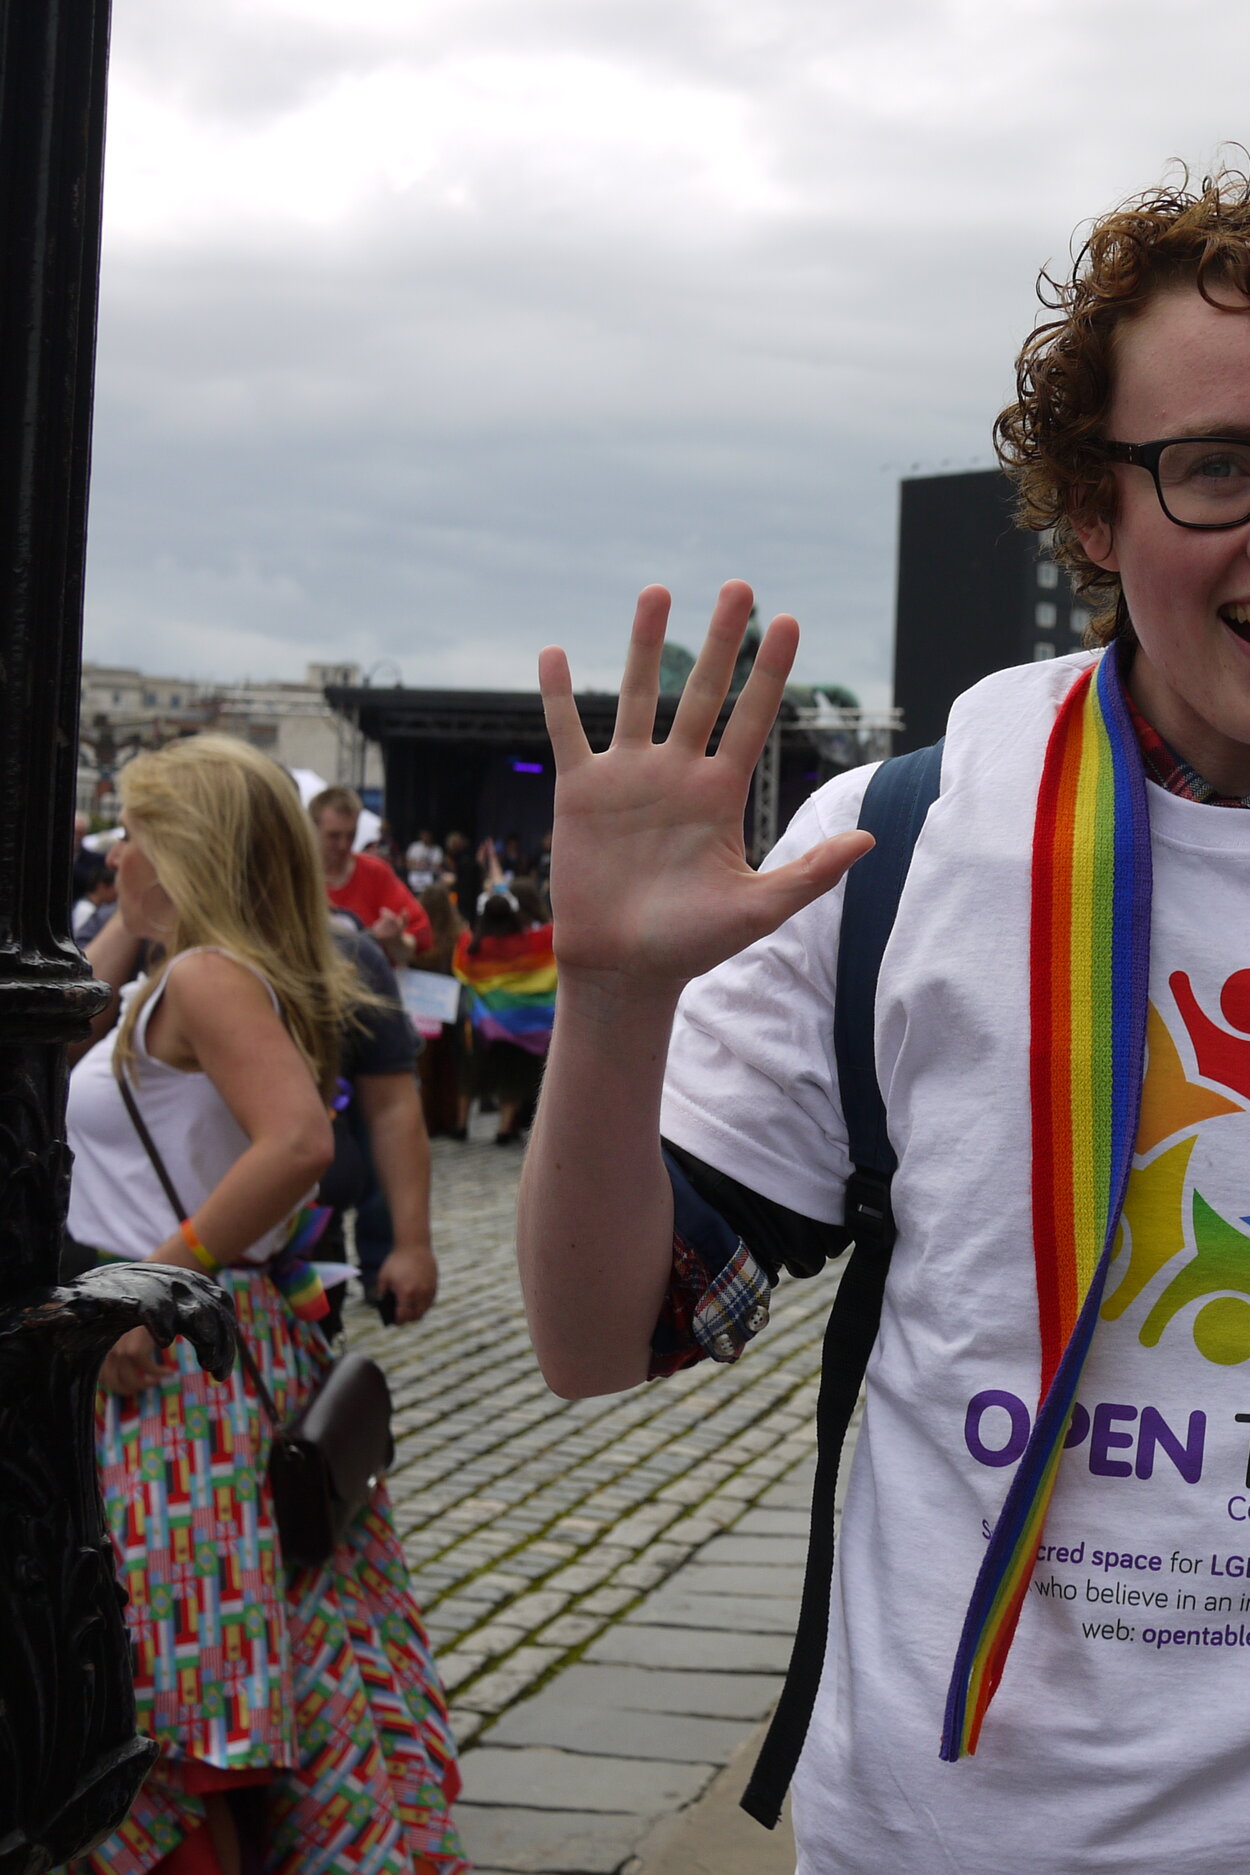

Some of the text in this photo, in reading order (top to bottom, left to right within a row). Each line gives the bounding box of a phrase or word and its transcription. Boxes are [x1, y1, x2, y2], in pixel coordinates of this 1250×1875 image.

[1091, 1549, 1162, 1572] space
[1170, 1551, 1203, 1574] for
[1034, 1575, 1077, 1601] who
[1086, 1578, 1168, 1608] believe
[1176, 1588, 1196, 1610] in
[1204, 1593, 1232, 1612] an
[1082, 1618, 1135, 1642] web:
